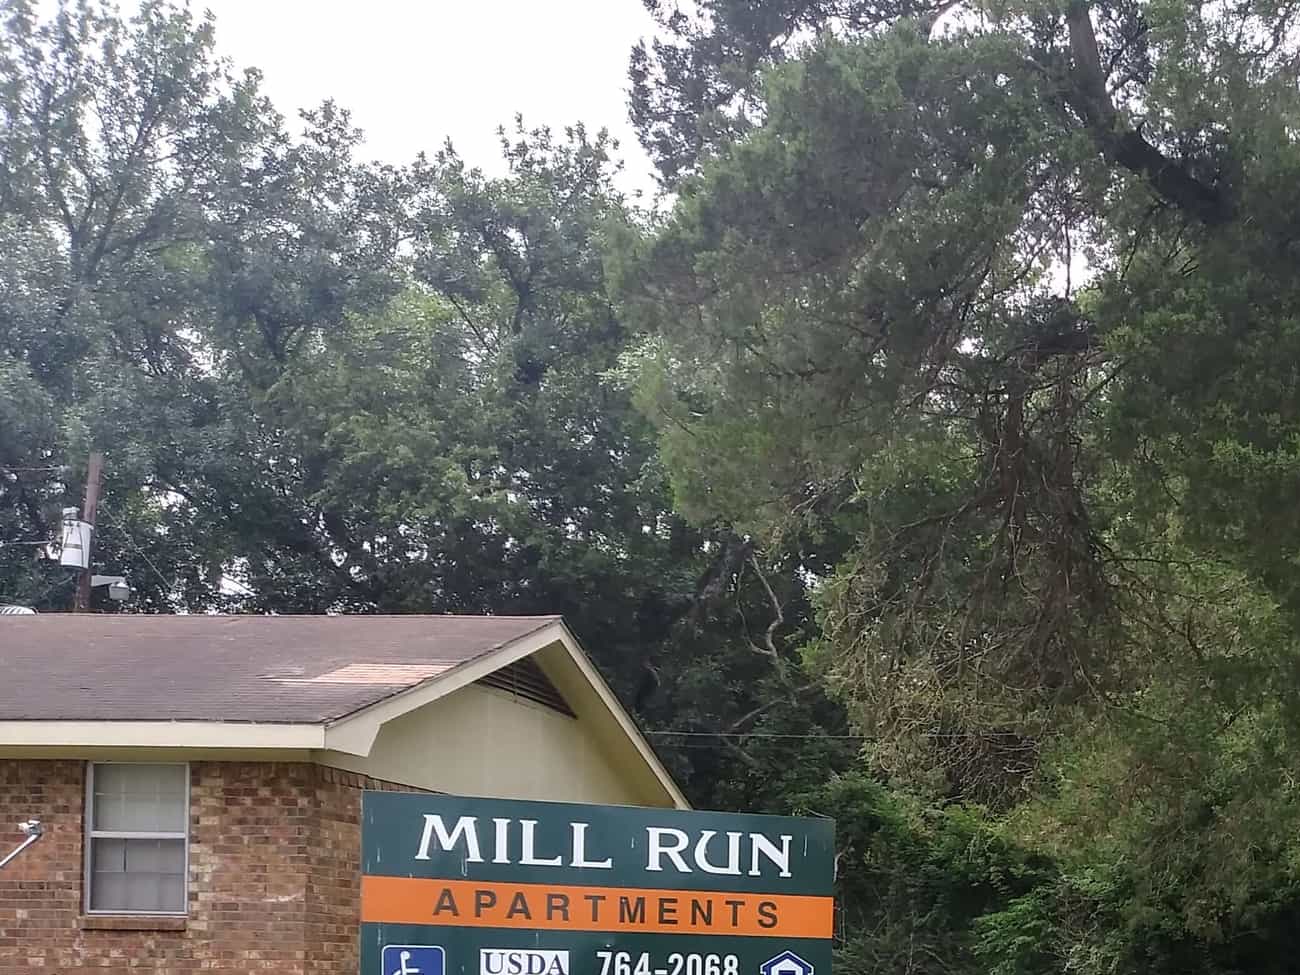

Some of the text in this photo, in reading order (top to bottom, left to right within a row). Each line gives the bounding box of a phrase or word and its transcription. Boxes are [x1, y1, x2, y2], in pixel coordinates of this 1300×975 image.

[415, 813, 793, 878] MILL RUN
[432, 888, 779, 929] APARTMENTS
[482, 952, 567, 975] USDA
